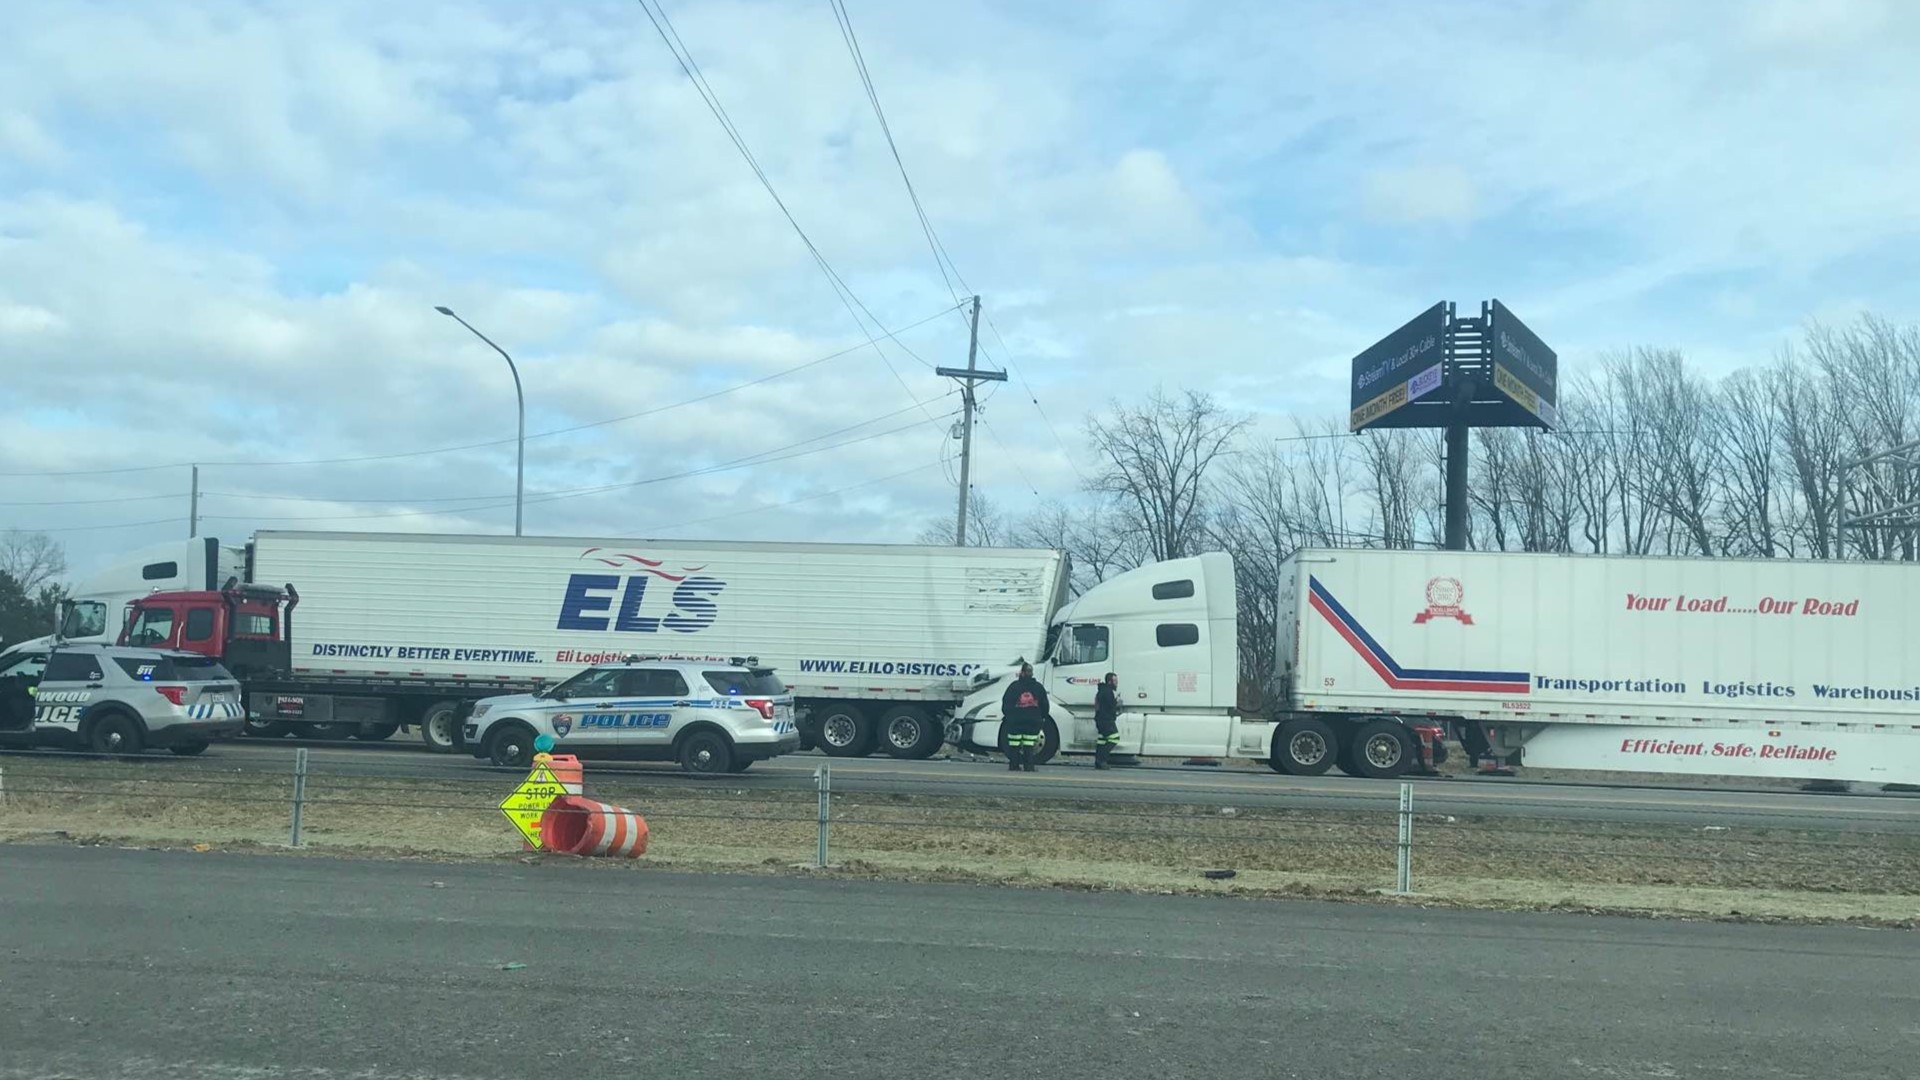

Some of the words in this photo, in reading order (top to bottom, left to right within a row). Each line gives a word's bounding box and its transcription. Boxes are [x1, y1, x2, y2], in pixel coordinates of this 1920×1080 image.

[557, 574, 727, 632] ELS
[1626, 593, 1672, 611] Your
[1802, 598, 1860, 616] Road
[312, 643, 393, 658] DISTINCTLY
[397, 646, 450, 660] BETTER
[556, 650, 575, 662] Eli
[576, 651, 628, 664] Logistic
[1324, 678, 1335, 686] 53
[1535, 675, 1686, 693] Transportation
[1703, 681, 1795, 698] Logistics
[37, 691, 91, 702] WOOD
[579, 714, 672, 729] POLICE
[1759, 744, 1837, 761] Reliable
[526, 786, 556, 800] STOP
